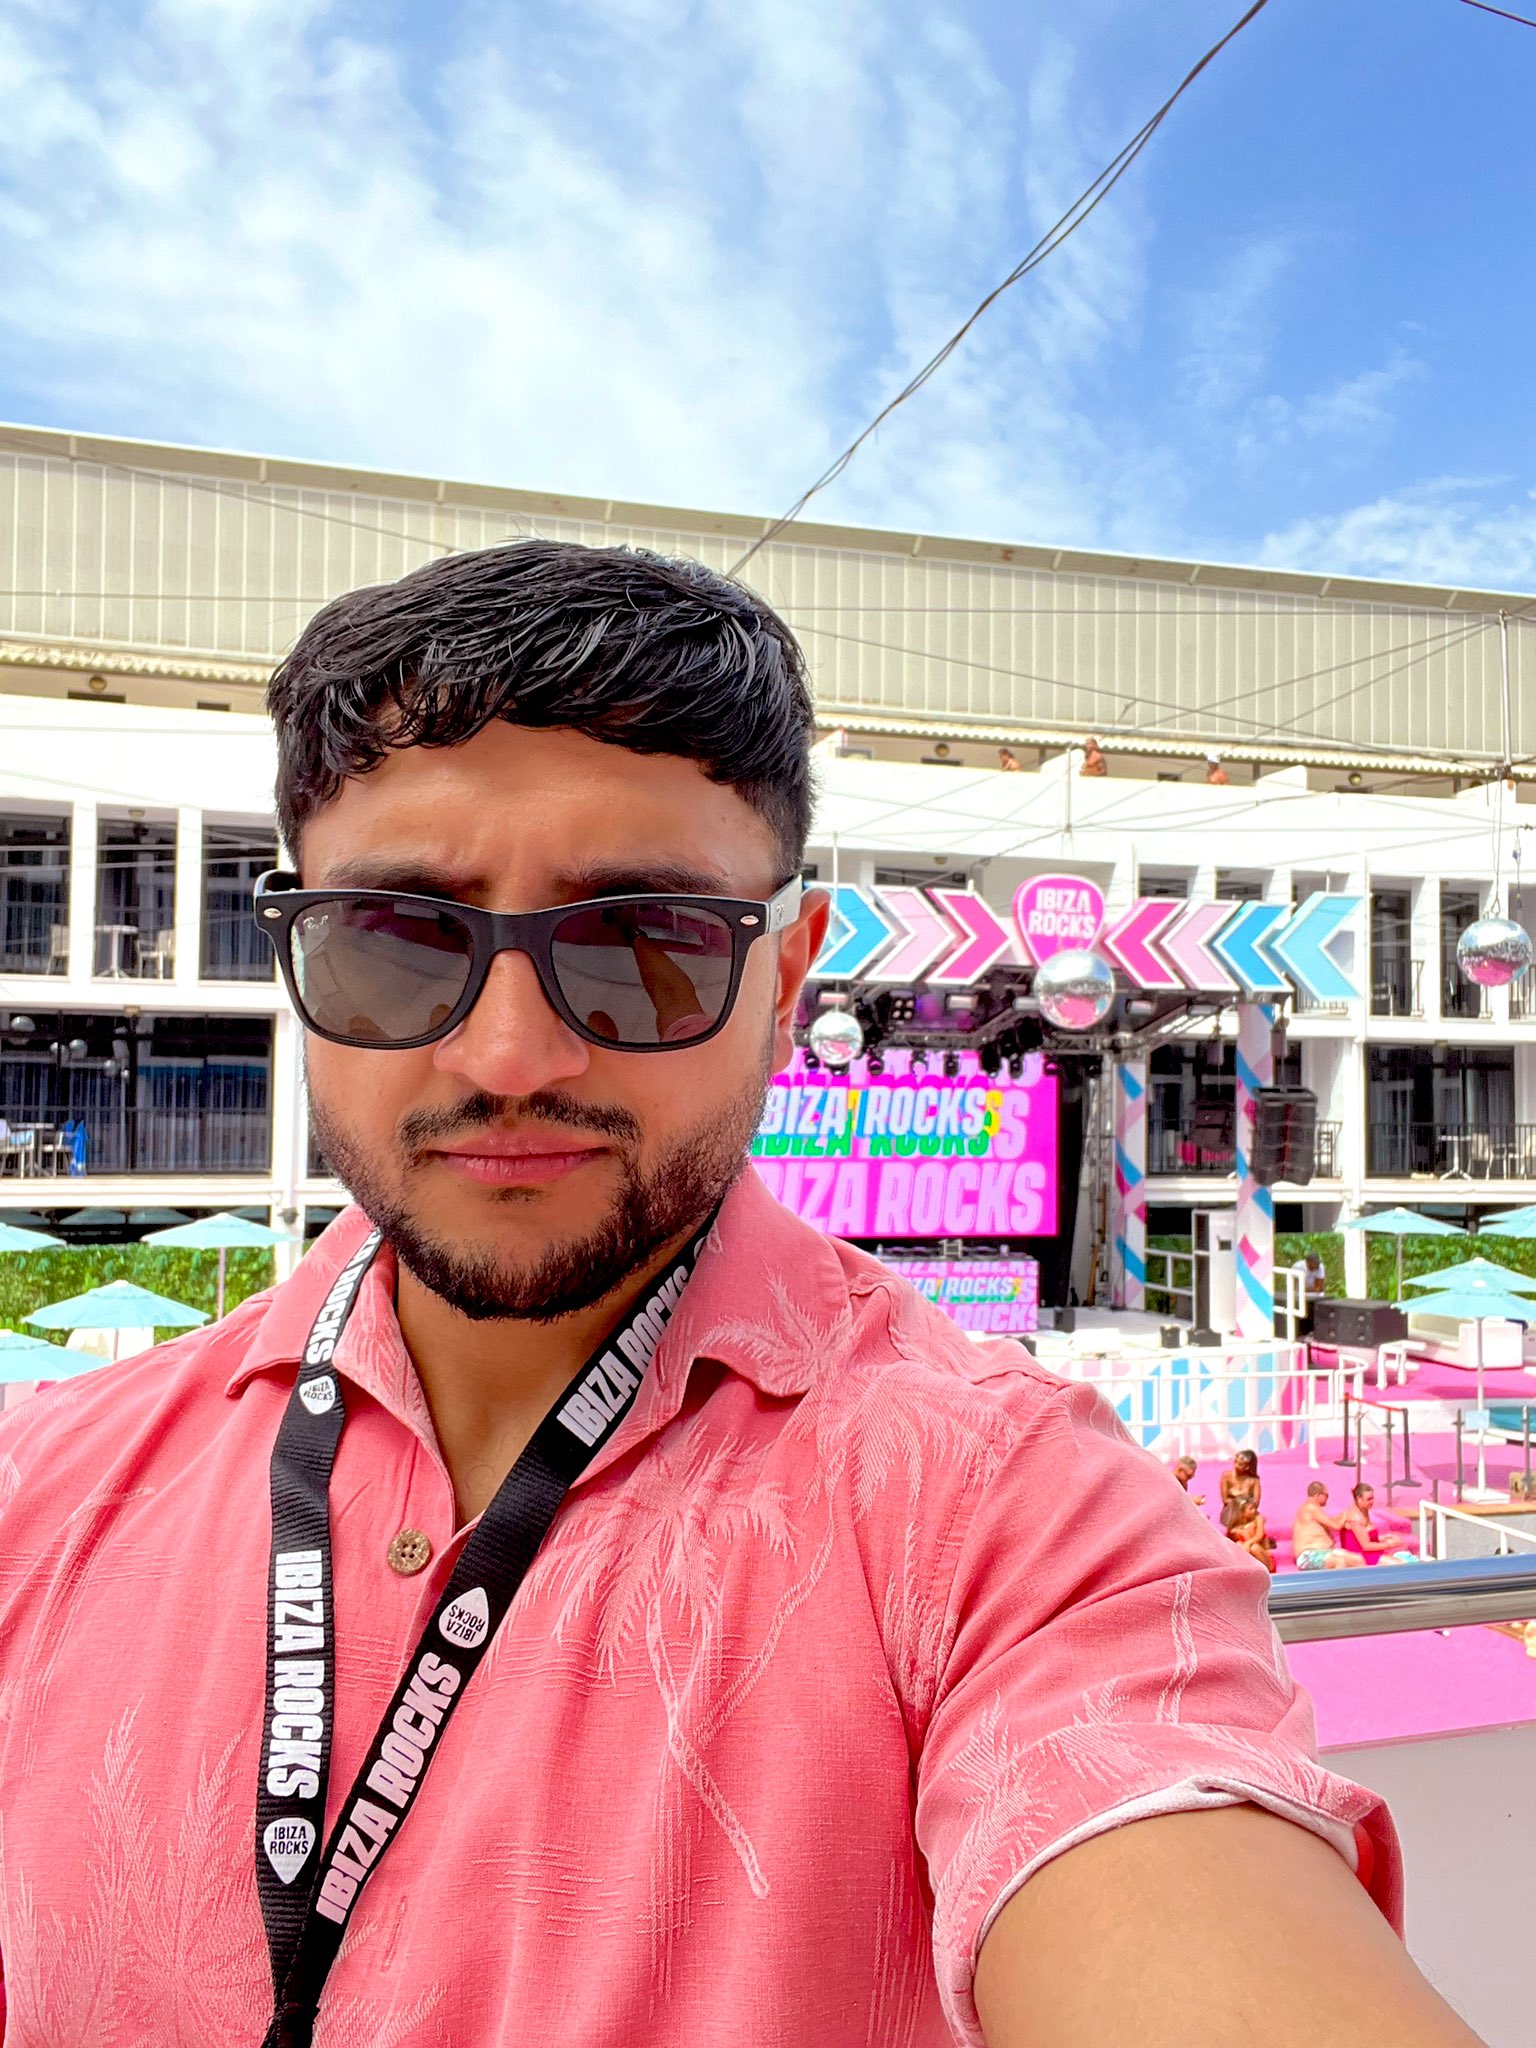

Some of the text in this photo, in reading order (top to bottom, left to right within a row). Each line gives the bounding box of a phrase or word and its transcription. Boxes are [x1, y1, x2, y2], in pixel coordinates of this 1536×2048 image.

[1036, 888, 1090, 913] IBIZA
[1028, 910, 1097, 940] ROCKS
[759, 1086, 847, 1135] BIZA
[865, 1086, 986, 1135] ROCKS
[875, 1162, 1046, 1235] ROCKS
[947, 1276, 1015, 1296] ROCKS
[306, 1263, 364, 1364] ROCKS
[303, 1390, 334, 1401] ROCKS
[557, 1350, 639, 1447] IBIZA
[446, 1619, 477, 1642] IBIZA
[449, 1604, 486, 1632] ROCKS
[266, 1549, 325, 1799] IBIZA ROCKS
[316, 1652, 461, 1925] IBIZA ROCKS
[274, 1825, 307, 1840] IBIZA
[270, 1840, 309, 1855] ROCKS
